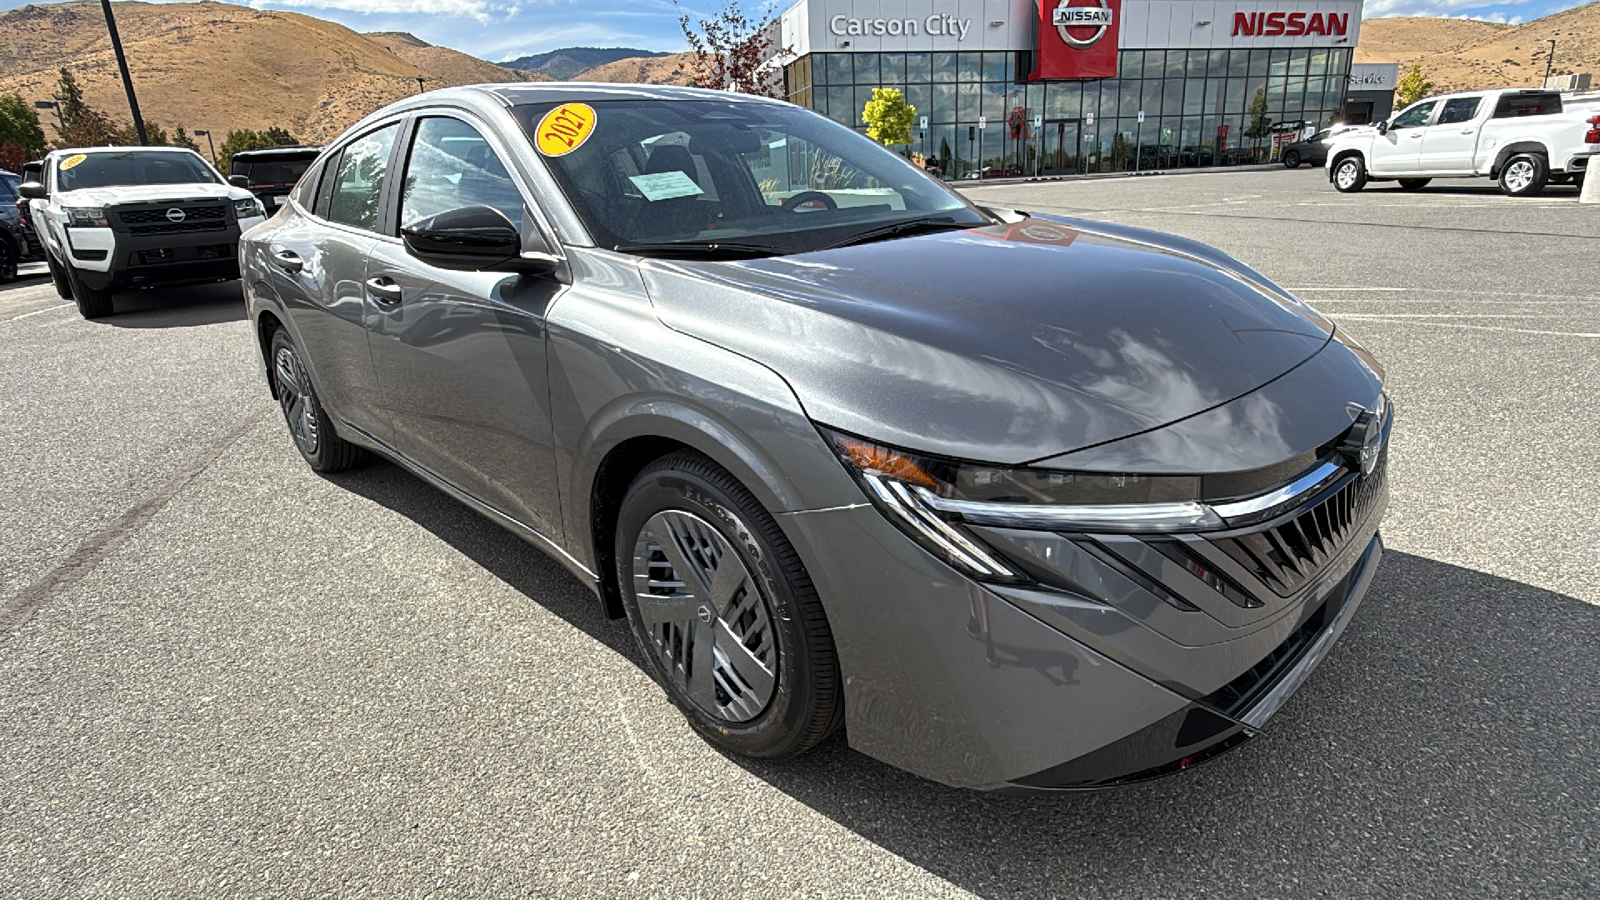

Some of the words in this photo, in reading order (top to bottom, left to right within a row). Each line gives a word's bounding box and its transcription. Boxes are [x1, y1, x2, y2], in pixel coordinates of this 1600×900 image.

[830, 14, 918, 36] Carson
[925, 13, 971, 41] City
[1061, 11, 1109, 22] NISSAN
[1233, 12, 1349, 36] NISSAN
[1349, 73, 1387, 84] Service
[545, 108, 586, 147] 2027
